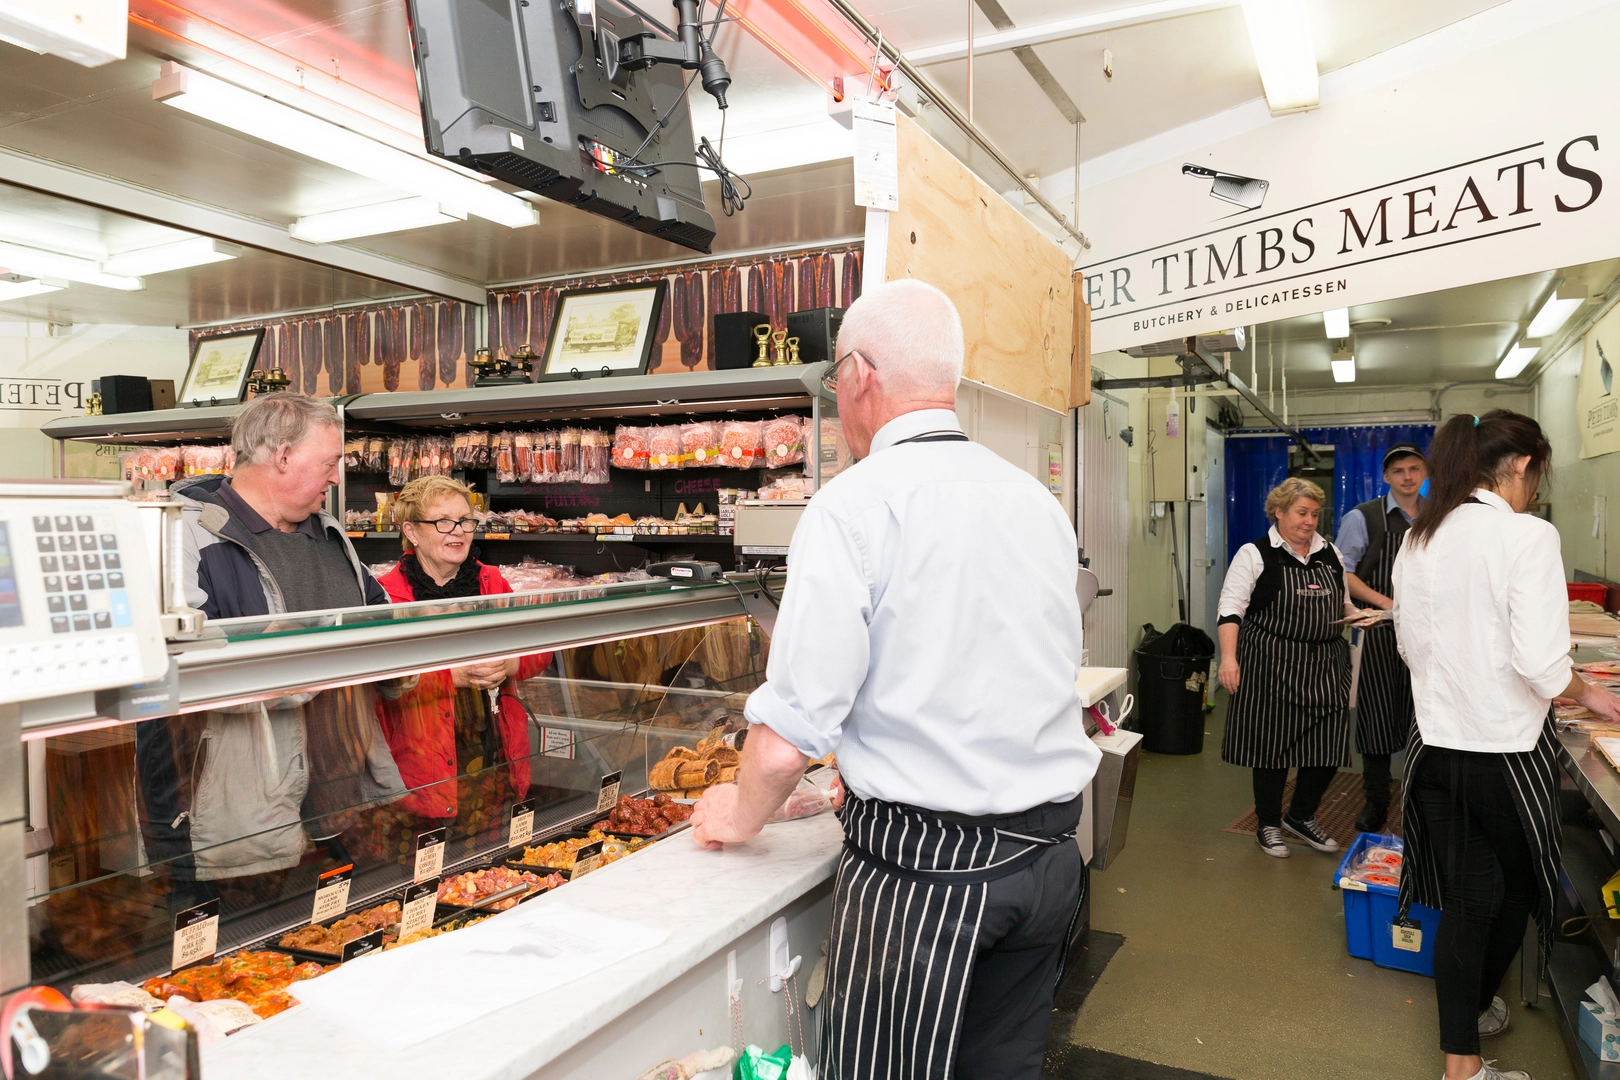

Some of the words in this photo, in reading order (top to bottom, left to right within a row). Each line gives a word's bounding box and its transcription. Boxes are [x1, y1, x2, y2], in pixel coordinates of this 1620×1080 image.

[1151, 217, 1316, 296] TIMBS
[1337, 134, 1603, 255] MEATS
[1133, 308, 1204, 332] BUTCHERY
[1210, 305, 1219, 316] &
[1225, 279, 1348, 313] DELICATESSEN
[674, 478, 720, 495] CHEESE
